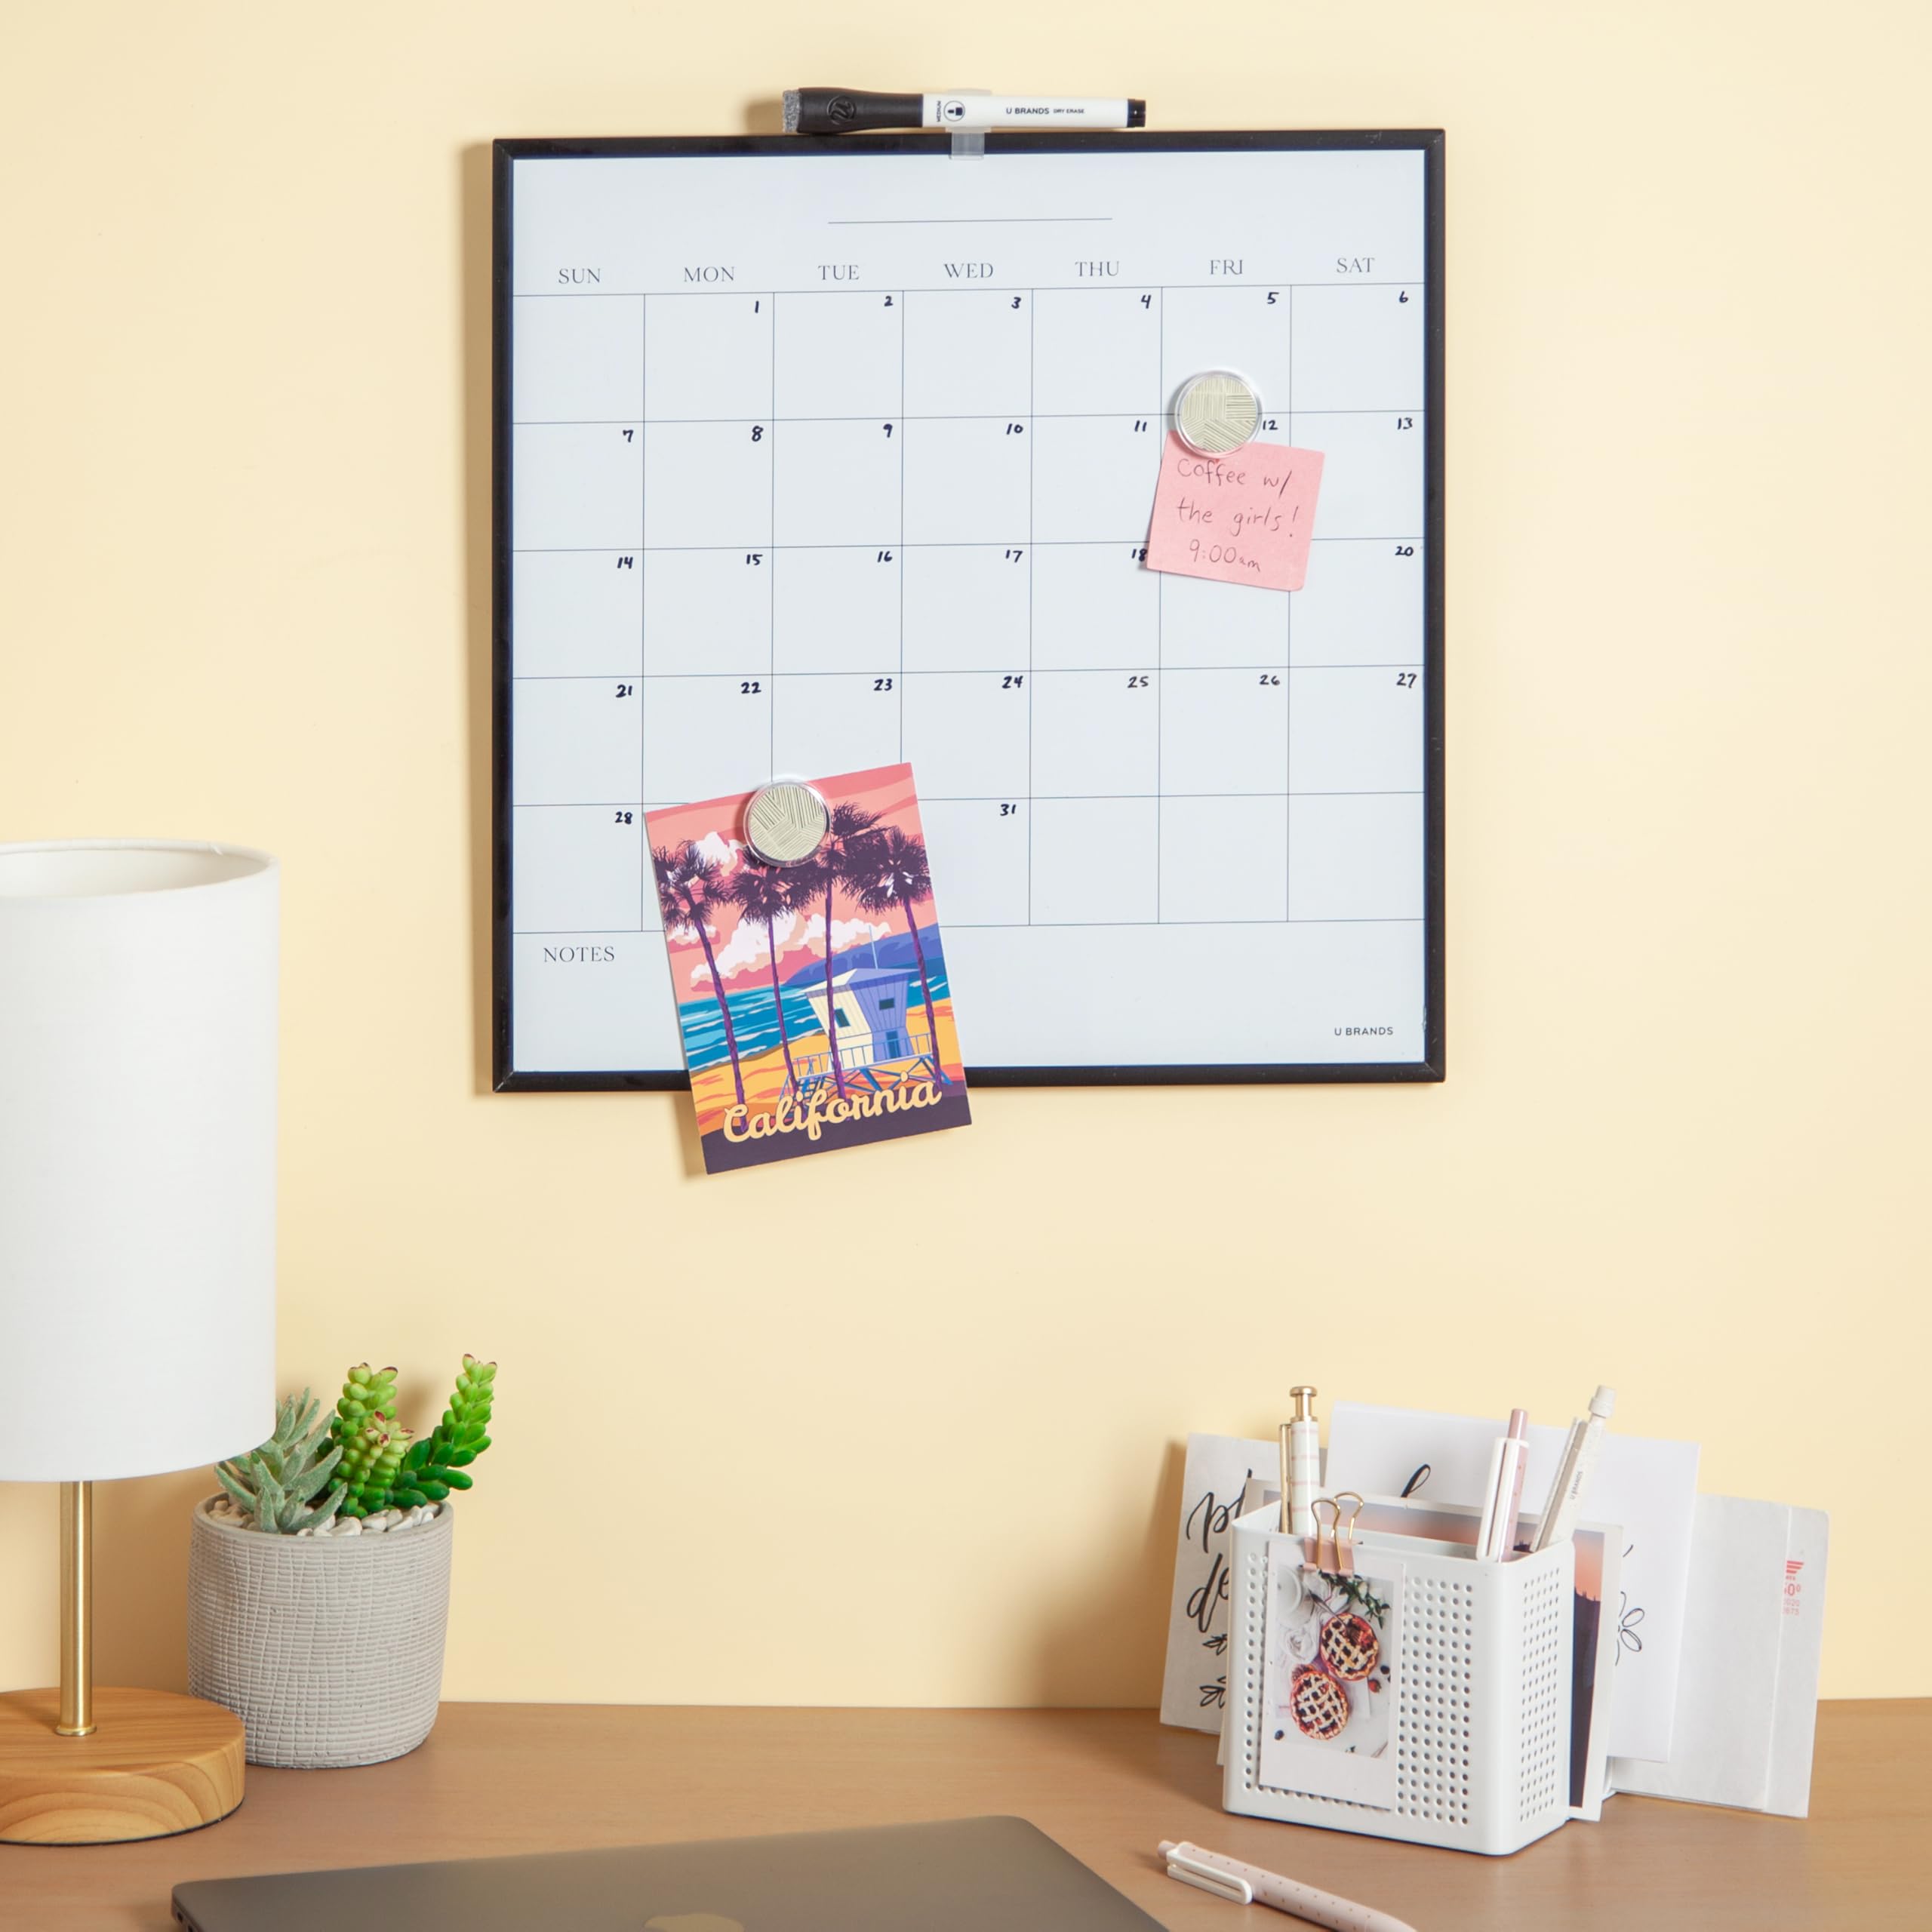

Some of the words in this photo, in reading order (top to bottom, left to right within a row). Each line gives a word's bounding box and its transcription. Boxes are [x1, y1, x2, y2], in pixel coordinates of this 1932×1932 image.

[558, 268, 601, 285] SUN
[684, 266, 735, 282] MON
[817, 265, 860, 281] TUE
[943, 263, 994, 278] WED
[1075, 261, 1120, 277] THU
[1210, 259, 1244, 275] FRI
[1336, 257, 1375, 273] SAT
[754, 300, 760, 314] 1
[884, 295, 894, 307] 2
[1011, 296, 1022, 309] 3
[1140, 294, 1152, 309] 4
[1266, 291, 1280, 305] 5
[1398, 290, 1409, 304] 6
[622, 429, 635, 444] 7
[751, 425, 764, 442] 8
[882, 423, 894, 438] 9
[1005, 423, 1024, 435] 10
[1134, 420, 1148, 432] 11
[1262, 419, 1279, 431] 12
[1397, 417, 1414, 430] 13
[1177, 458, 1246, 486] Coffee
[1263, 469, 1293, 499] w/
[1177, 497, 1214, 524] the
[1230, 506, 1299, 537] girls!
[617, 555, 634, 570] 14
[746, 553, 764, 566] 15
[876, 550, 894, 564] 16
[1004, 549, 1024, 564] 17
[1131, 548, 1148, 562] 18
[1394, 545, 1414, 557] 20
[615, 684, 633, 699] 21
[740, 681, 762, 695] 22
[873, 678, 893, 692] 23
[1001, 676, 1024, 690] 24
[1127, 675, 1149, 689] 25
[1259, 674, 1281, 686] 26
[1395, 672, 1418, 689] 27
[614, 811, 633, 826] 28
[999, 803, 1017, 817] 31
[543, 946, 615, 963] NOTES
[1334, 1027, 1342, 1036] U
[1346, 1026, 1394, 1036] BRANDS
[723, 1070, 943, 1143] California
